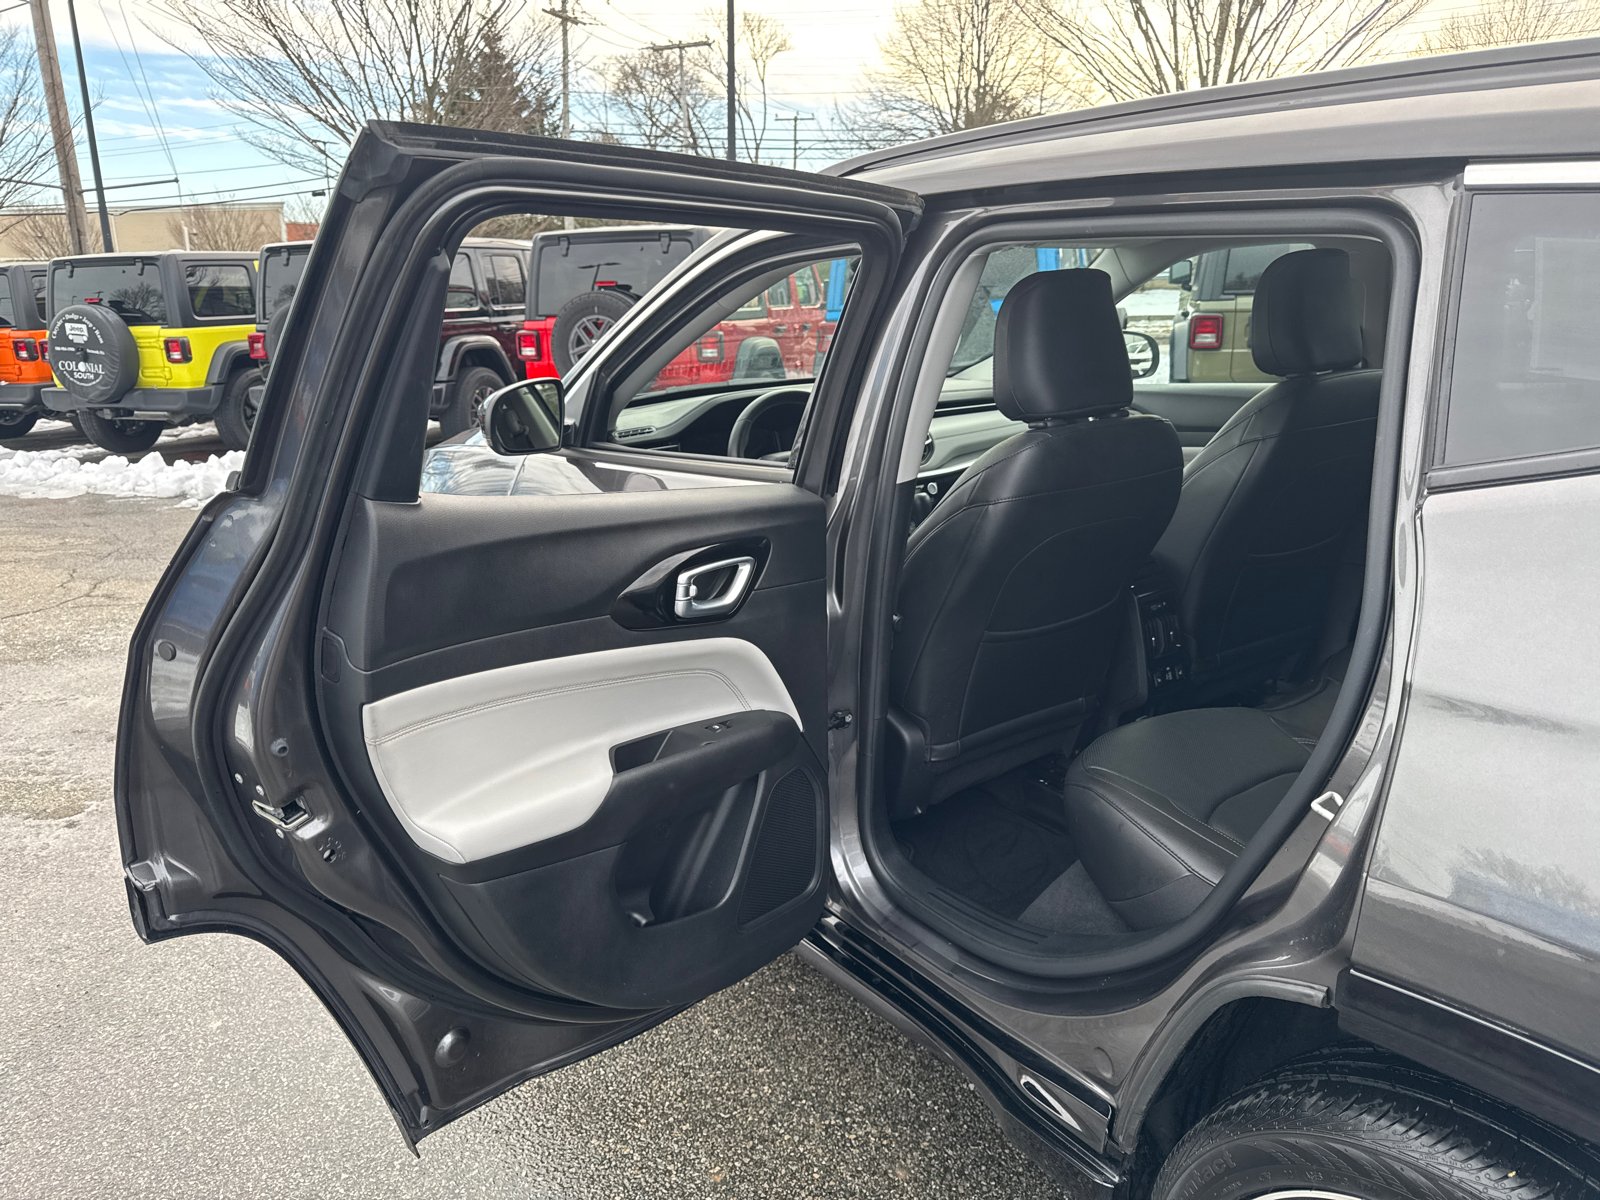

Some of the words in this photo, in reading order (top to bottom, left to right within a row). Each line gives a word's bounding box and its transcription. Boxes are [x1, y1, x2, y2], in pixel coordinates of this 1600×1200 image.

[68, 325, 85, 333] Jeep
[58, 360, 105, 374] COLONIAL
[73, 371, 94, 380] SOUTH
